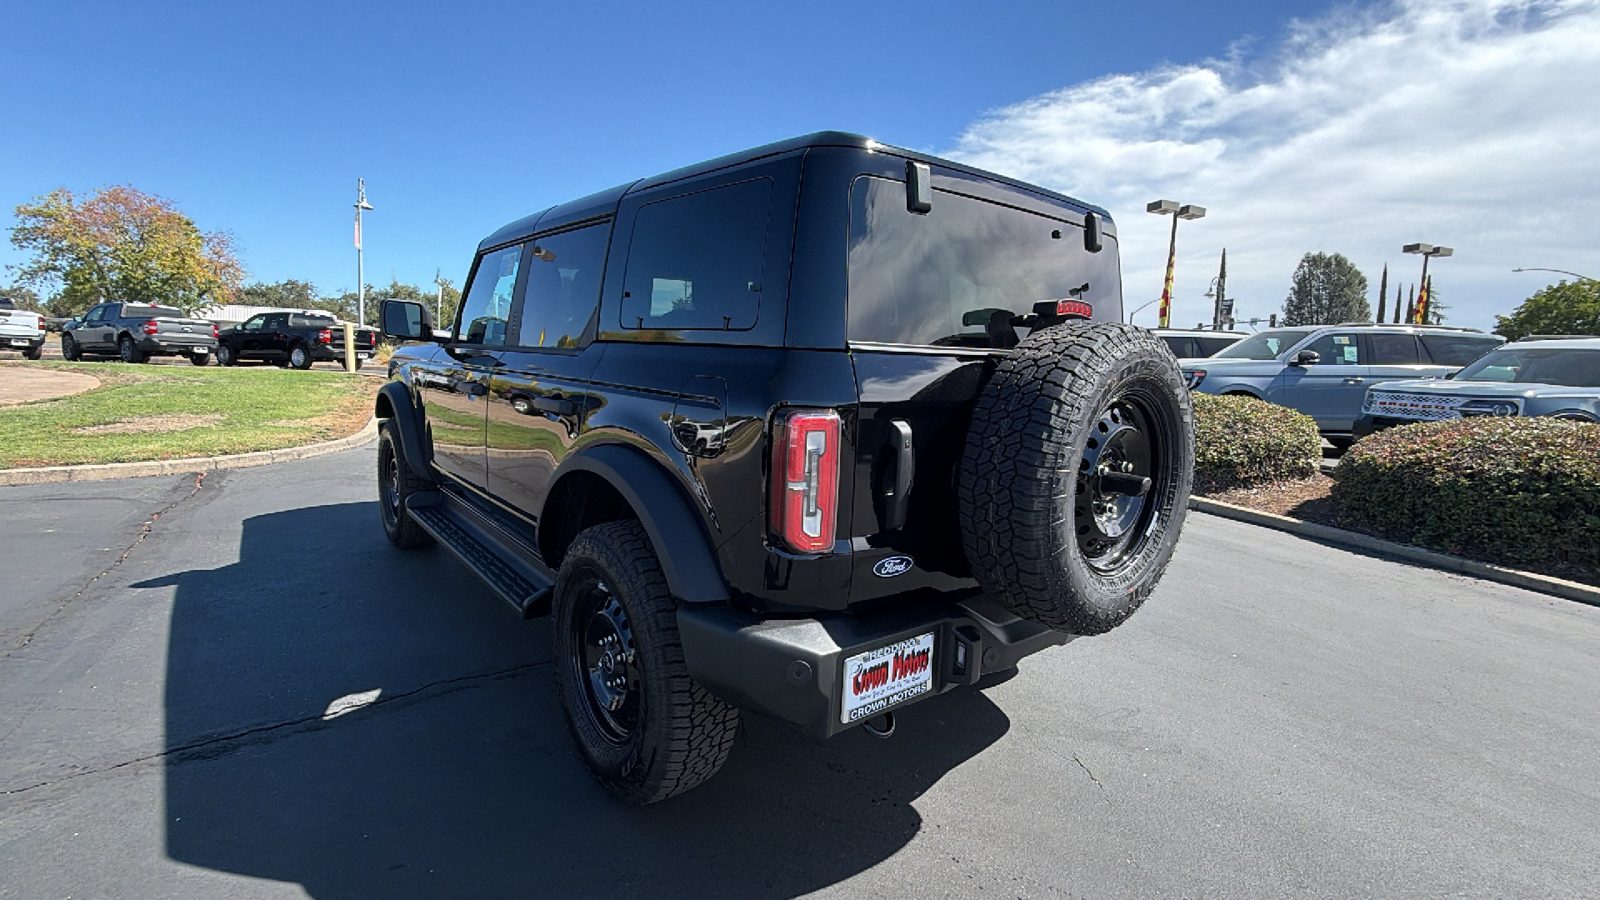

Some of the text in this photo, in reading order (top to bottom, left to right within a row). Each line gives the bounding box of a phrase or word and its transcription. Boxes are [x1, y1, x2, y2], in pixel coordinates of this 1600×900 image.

[1379, 401, 1446, 410] BRONCO
[881, 559, 906, 574] Ford
[869, 639, 917, 661] REDDING
[852, 647, 930, 696] Crown Motors
[850, 682, 927, 719] CROWN MOTORS
